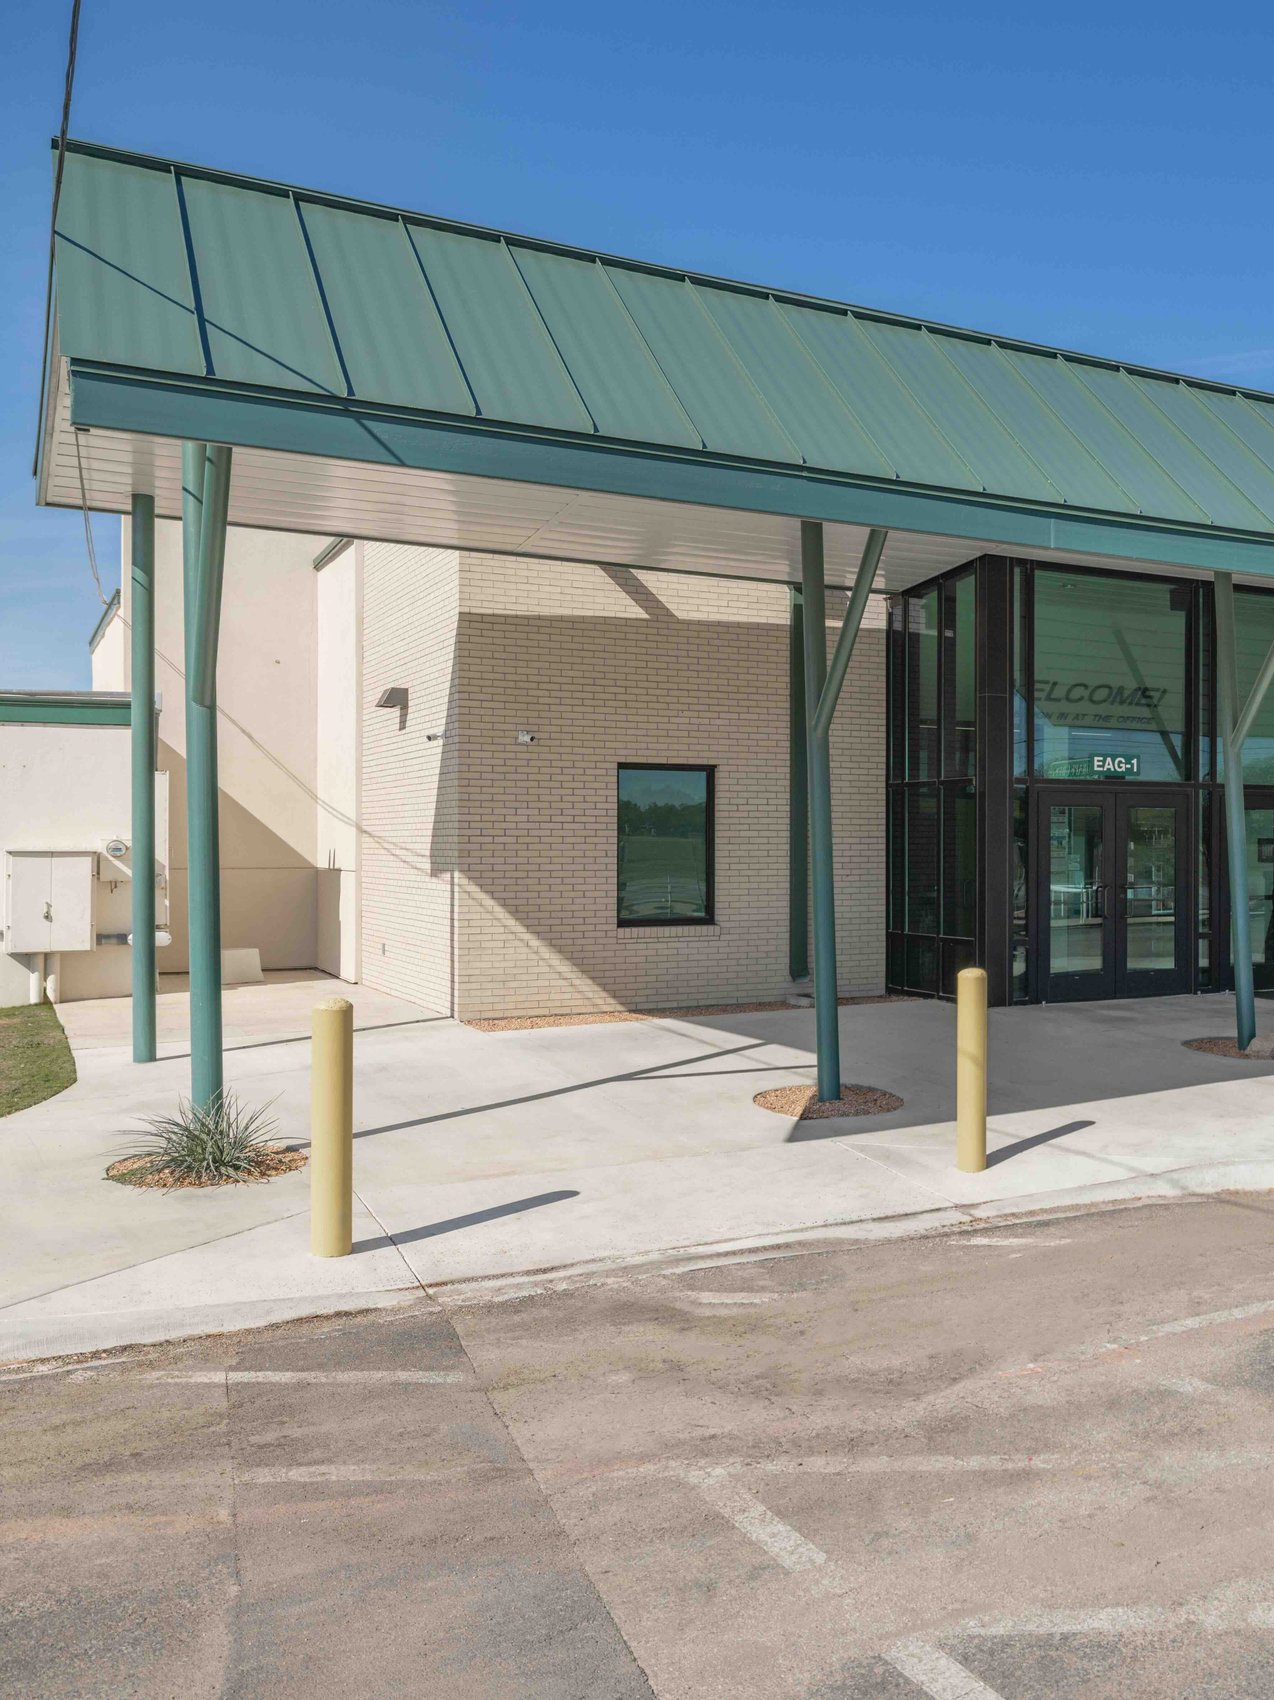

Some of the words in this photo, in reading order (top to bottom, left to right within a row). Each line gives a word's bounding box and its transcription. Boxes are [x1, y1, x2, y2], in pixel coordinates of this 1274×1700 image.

[1033, 679, 1168, 709] ELCOME!
[1071, 712, 1089, 721] AT
[1092, 713, 1113, 723] THE
[1093, 756, 1138, 772] EAG-1
